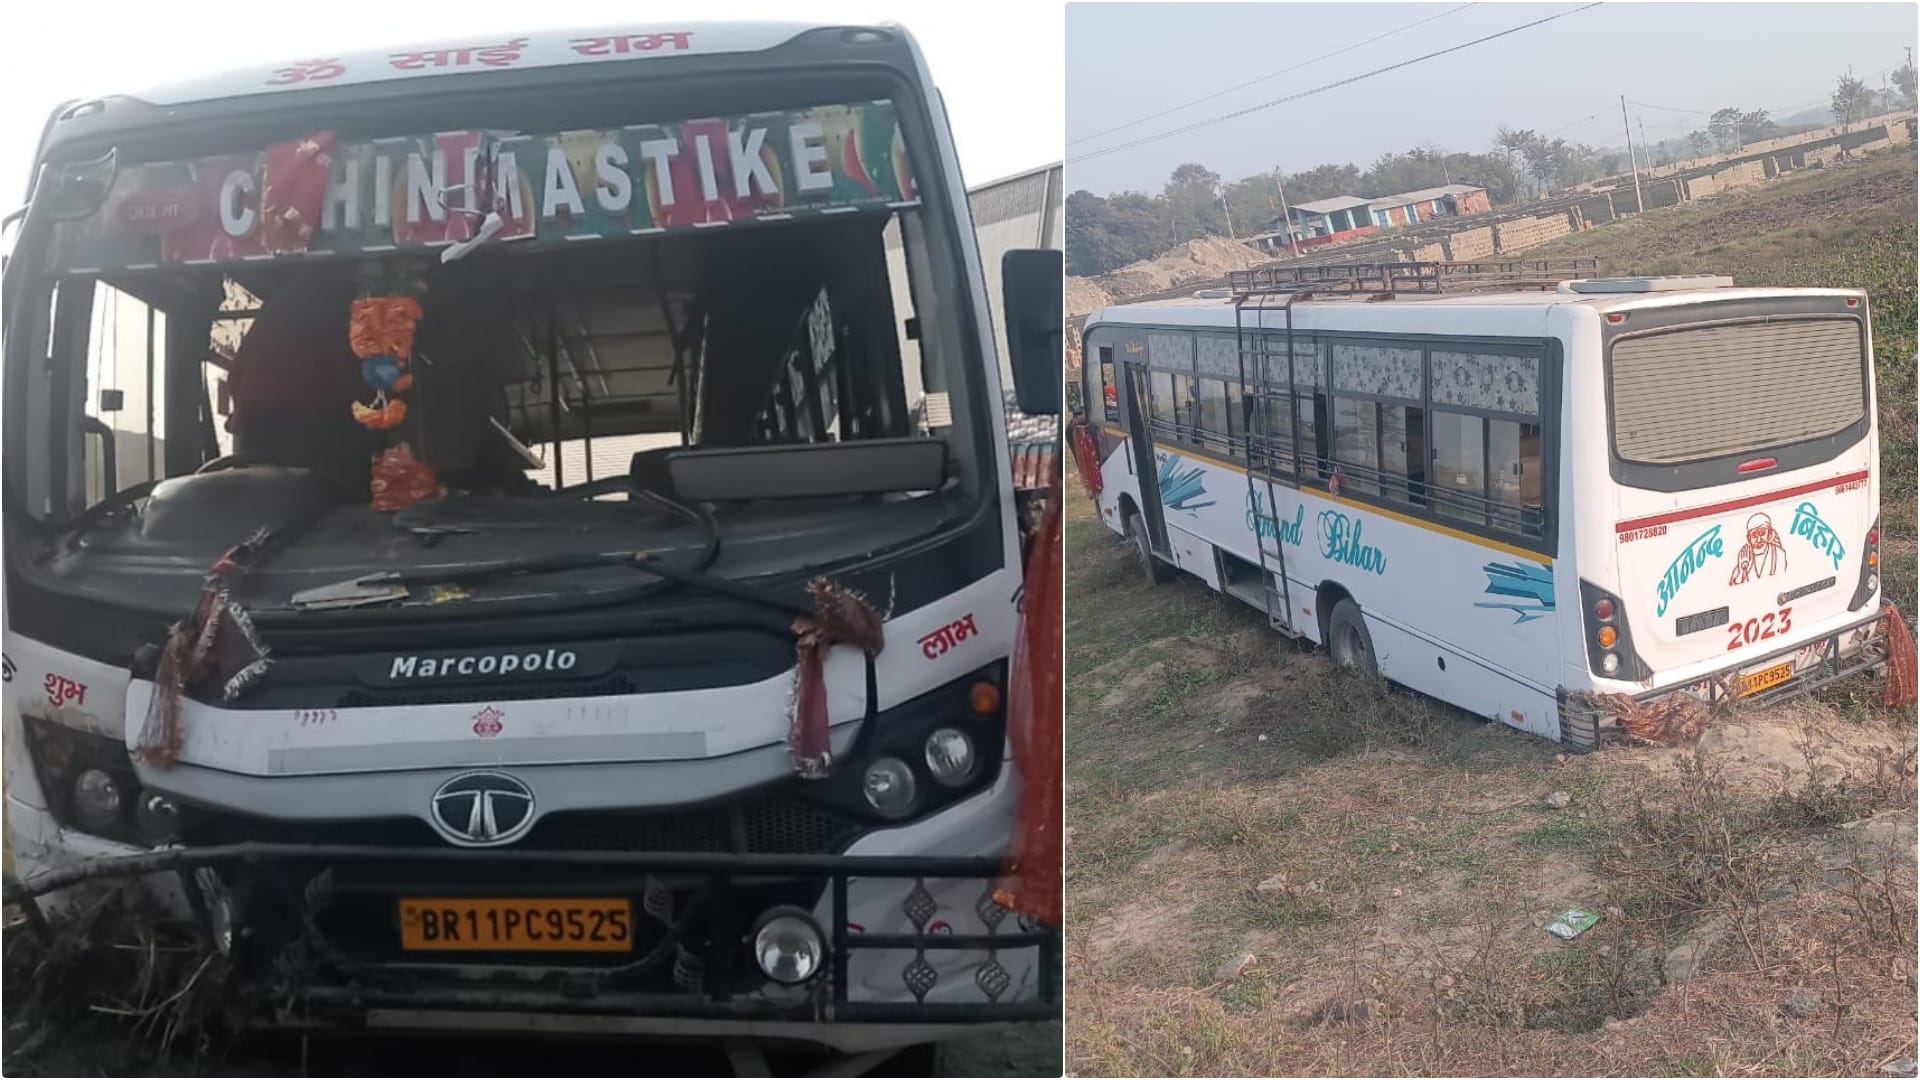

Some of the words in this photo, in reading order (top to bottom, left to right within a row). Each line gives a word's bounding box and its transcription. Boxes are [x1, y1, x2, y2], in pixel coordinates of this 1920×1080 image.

[389, 38, 529, 71] साई
[569, 31, 693, 56] राम
[217, 122, 833, 237] CHINMASTIKE
[1317, 510, 1387, 575] Bihar
[1656, 523, 1723, 617] आनन्द
[1789, 501, 1846, 571] बिहार
[917, 612, 978, 660] लाभ
[1727, 607, 1792, 651] 2023
[390, 649, 577, 679] Marcopolo
[44, 672, 88, 707] शुभ
[421, 908, 629, 942] BR11PC9525
